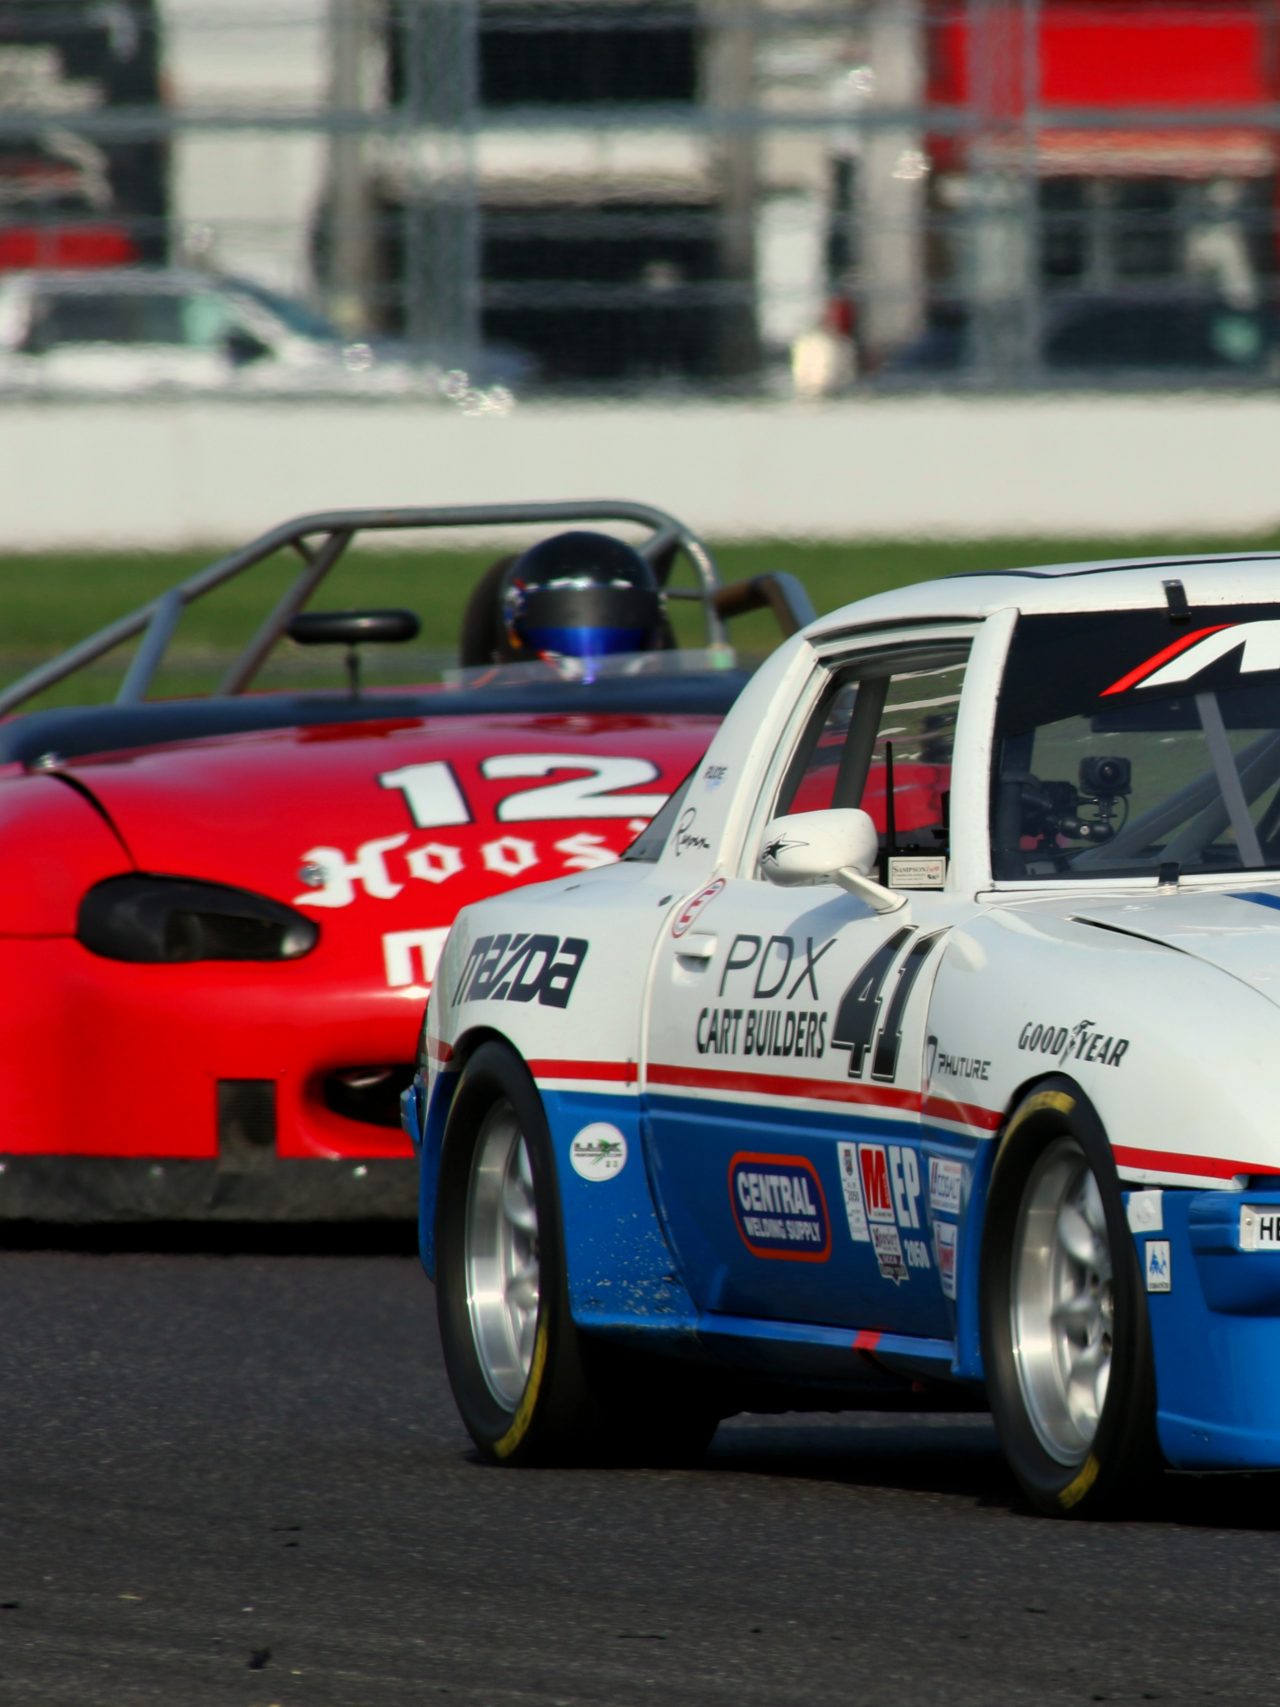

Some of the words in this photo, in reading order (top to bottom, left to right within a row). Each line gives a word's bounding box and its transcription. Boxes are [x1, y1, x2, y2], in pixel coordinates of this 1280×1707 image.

[376, 752, 672, 829] 12
[718, 934, 839, 1000] PDX
[831, 924, 955, 1084] 41
[696, 1006, 744, 1054] CART
[744, 1008, 828, 1059] BUILDERS
[937, 1053, 992, 1082] PHUTURE
[736, 1171, 817, 1216] CENTRAL
[743, 1216, 787, 1239] WELDING
[785, 1220, 822, 1243] SUPPLY
